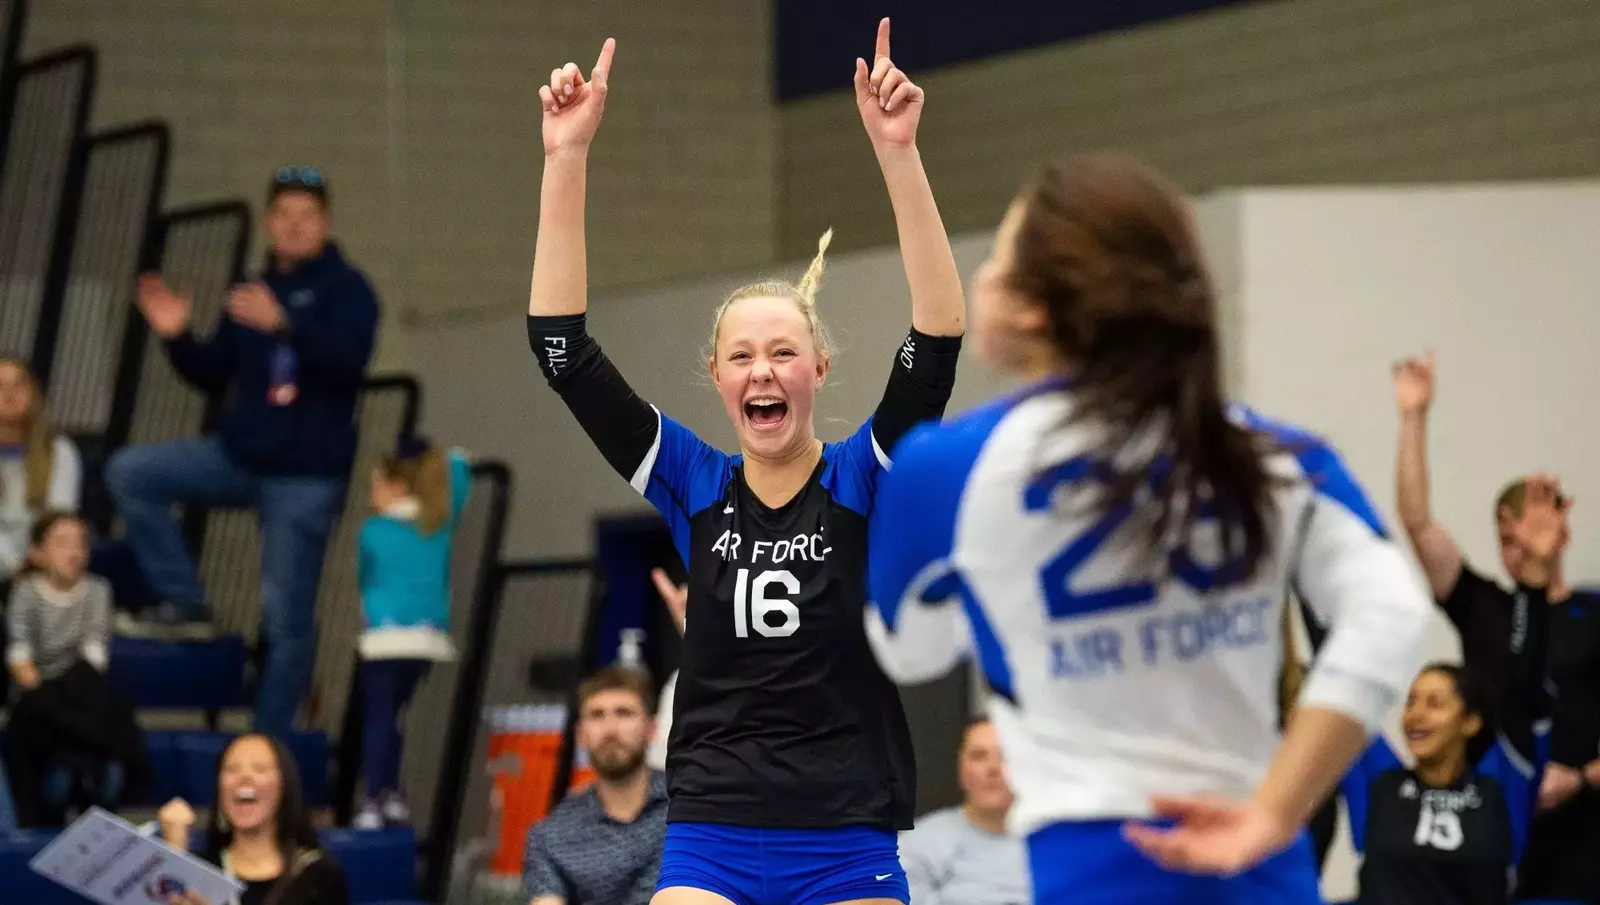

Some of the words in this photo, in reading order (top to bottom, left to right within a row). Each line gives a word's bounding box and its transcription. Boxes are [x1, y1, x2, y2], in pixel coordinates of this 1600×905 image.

[544, 336, 567, 376] FAL
[751, 525, 833, 564] FORC
[733, 568, 801, 638] 16
[1049, 626, 1124, 679] AIR
